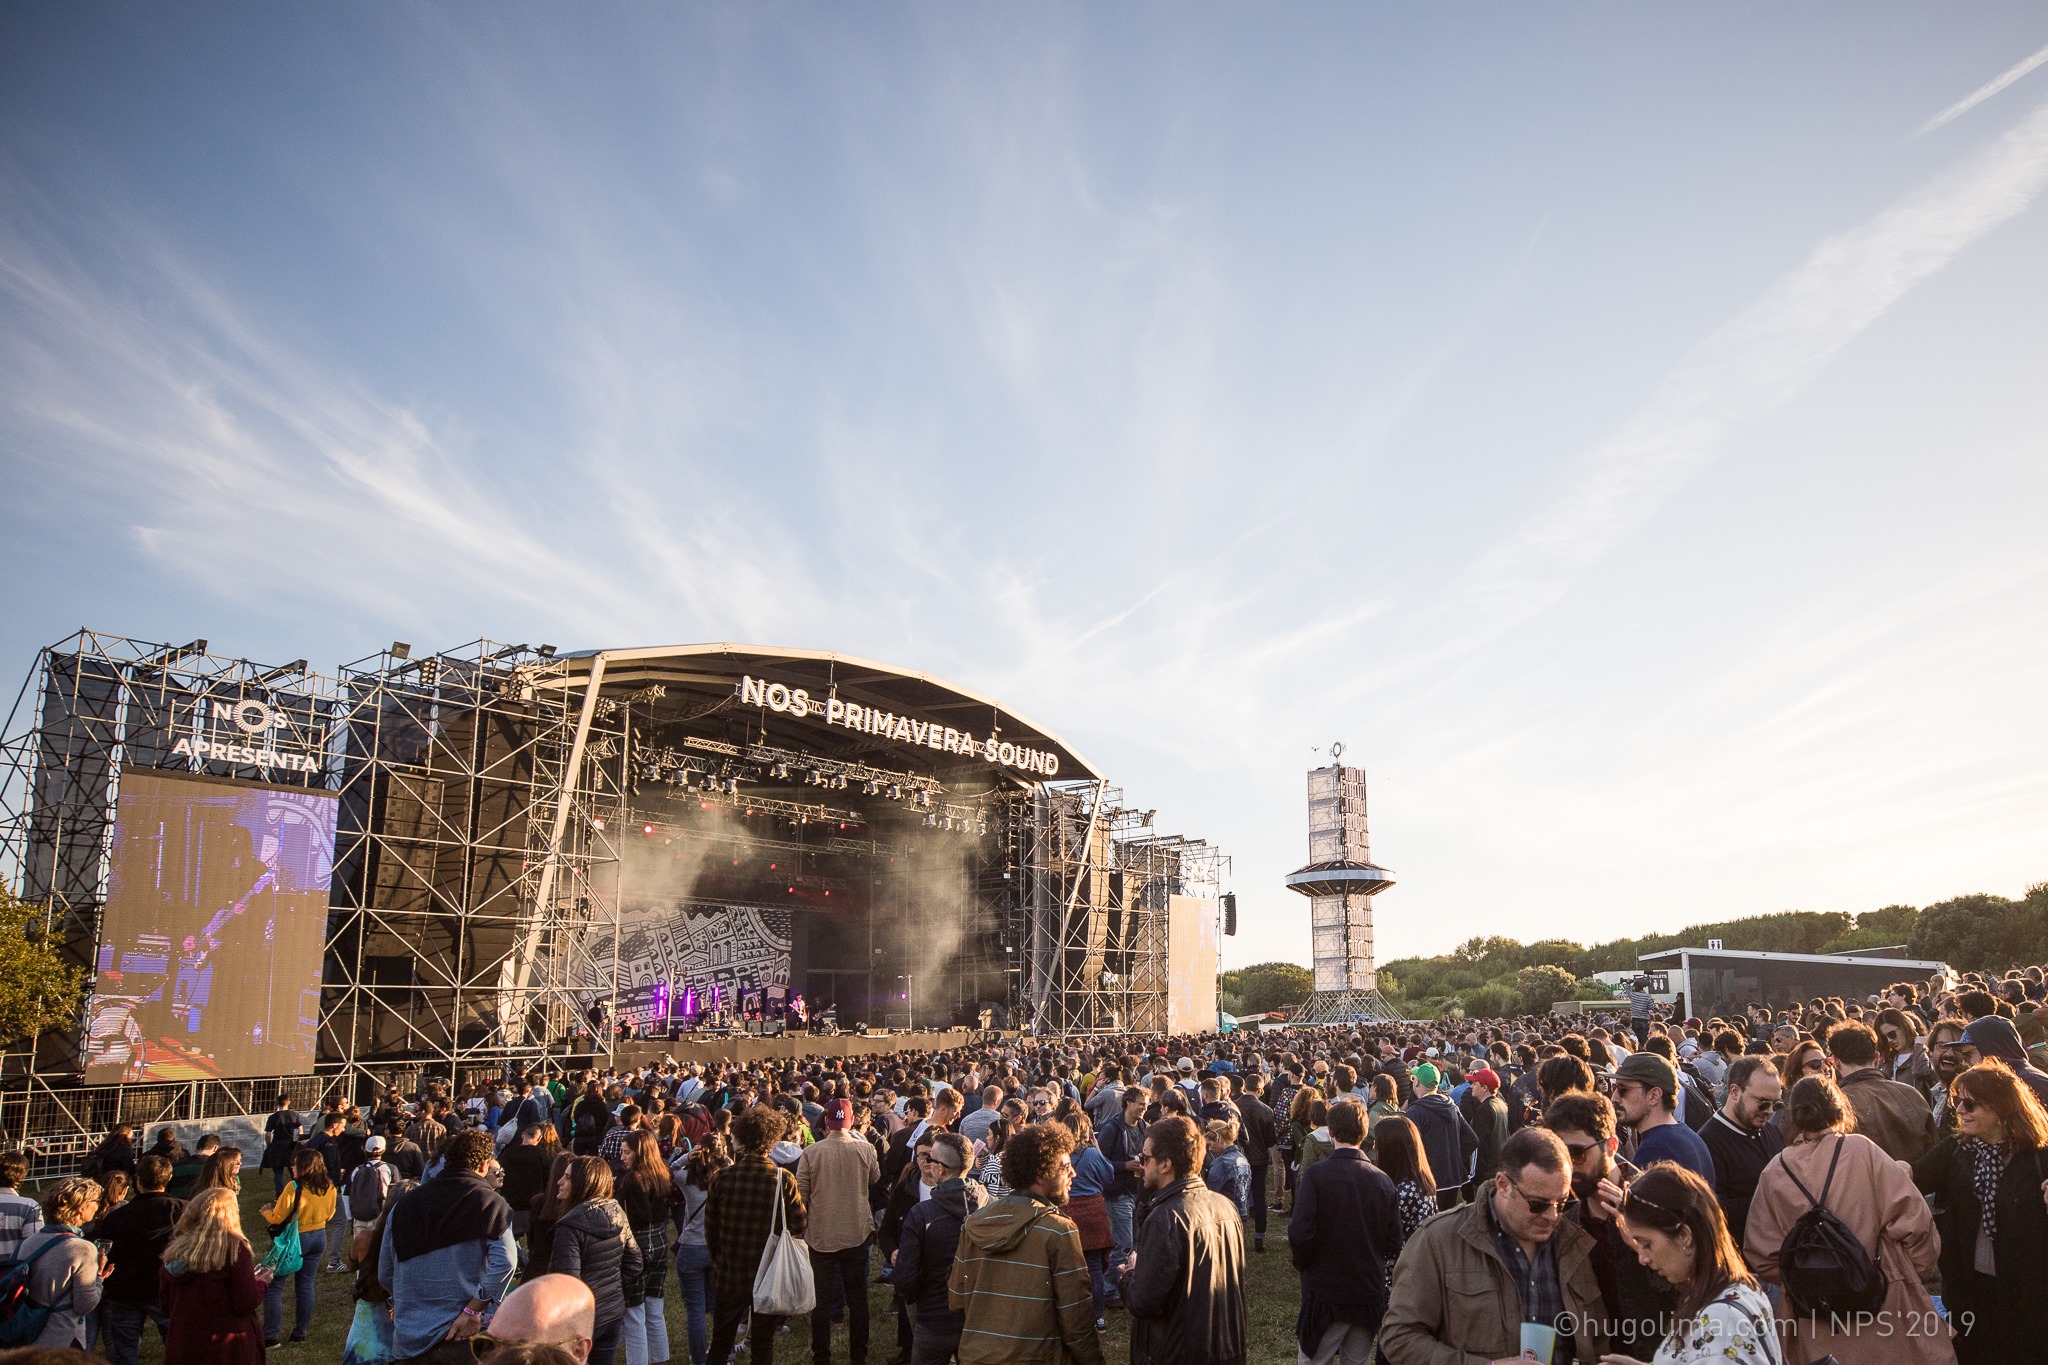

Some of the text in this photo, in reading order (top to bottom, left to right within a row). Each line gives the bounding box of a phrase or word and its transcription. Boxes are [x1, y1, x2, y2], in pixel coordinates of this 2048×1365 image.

[212, 699, 288, 733] NOS
[741, 675, 1059, 776] NOS PRIMAVERA SOUND
[171, 738, 319, 774] APRESENTA
